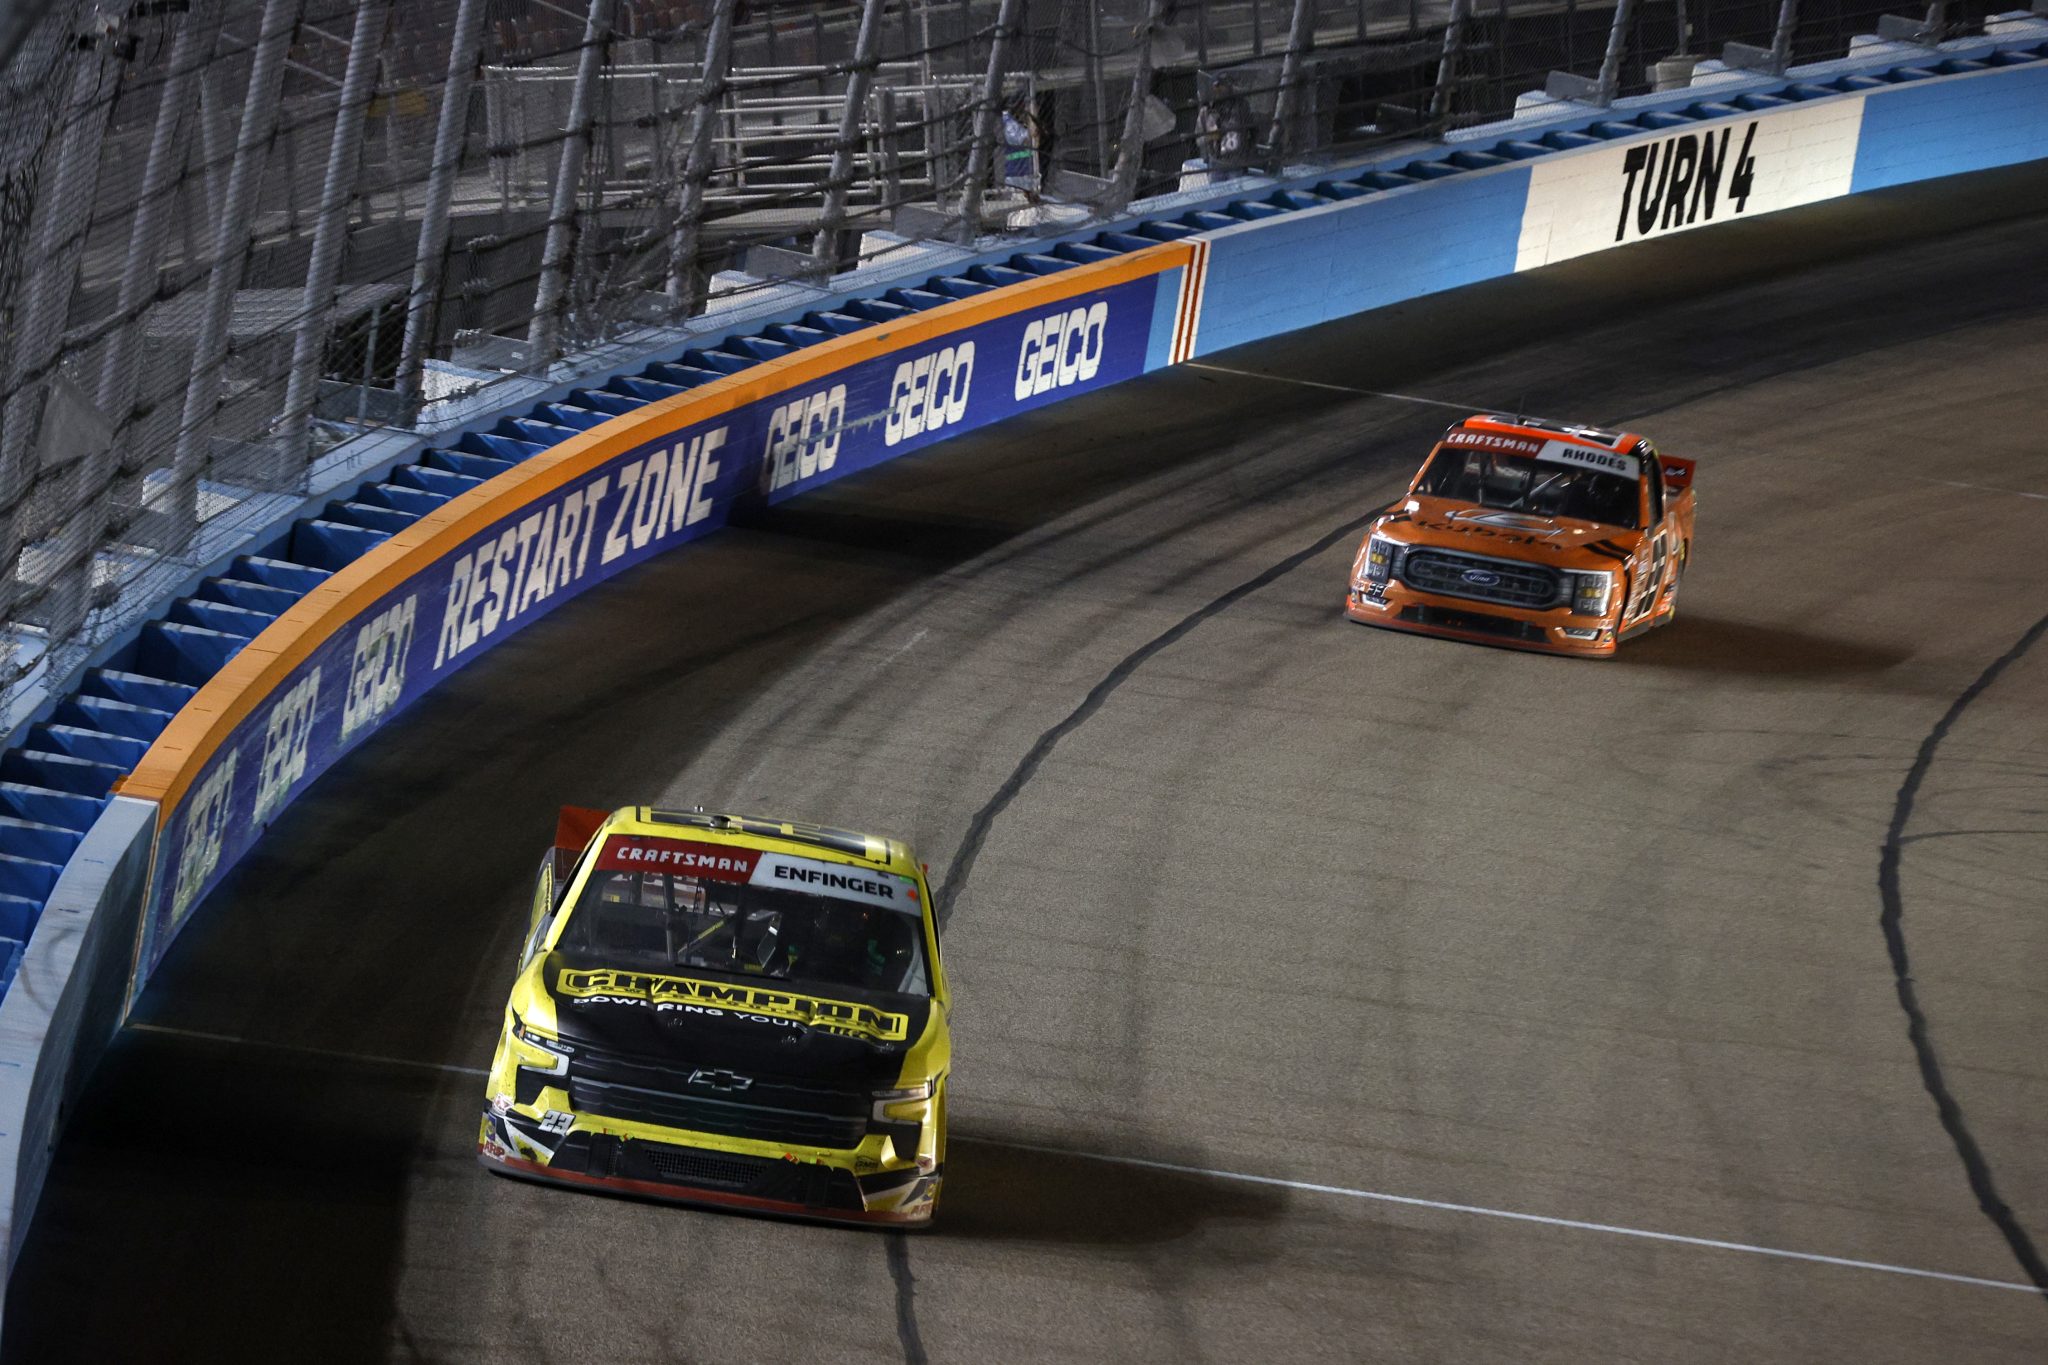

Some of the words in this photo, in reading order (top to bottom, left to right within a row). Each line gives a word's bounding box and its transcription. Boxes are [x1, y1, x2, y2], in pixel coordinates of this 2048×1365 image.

[1615, 127, 1732, 241] TURN
[1729, 121, 1759, 213] 4
[885, 341, 975, 447] GEICO
[1014, 301, 1108, 401] GEICO
[762, 384, 847, 492] GEICO
[1446, 433, 1540, 453] CRAFTSMAN
[1562, 448, 1627, 471] RHODES
[433, 476, 610, 671] RESTART
[600, 426, 729, 566] ZONE
[616, 846, 748, 872] CRAFTSMAN
[774, 865, 894, 899] ENFINGER
[538, 1110, 576, 1136] 23
